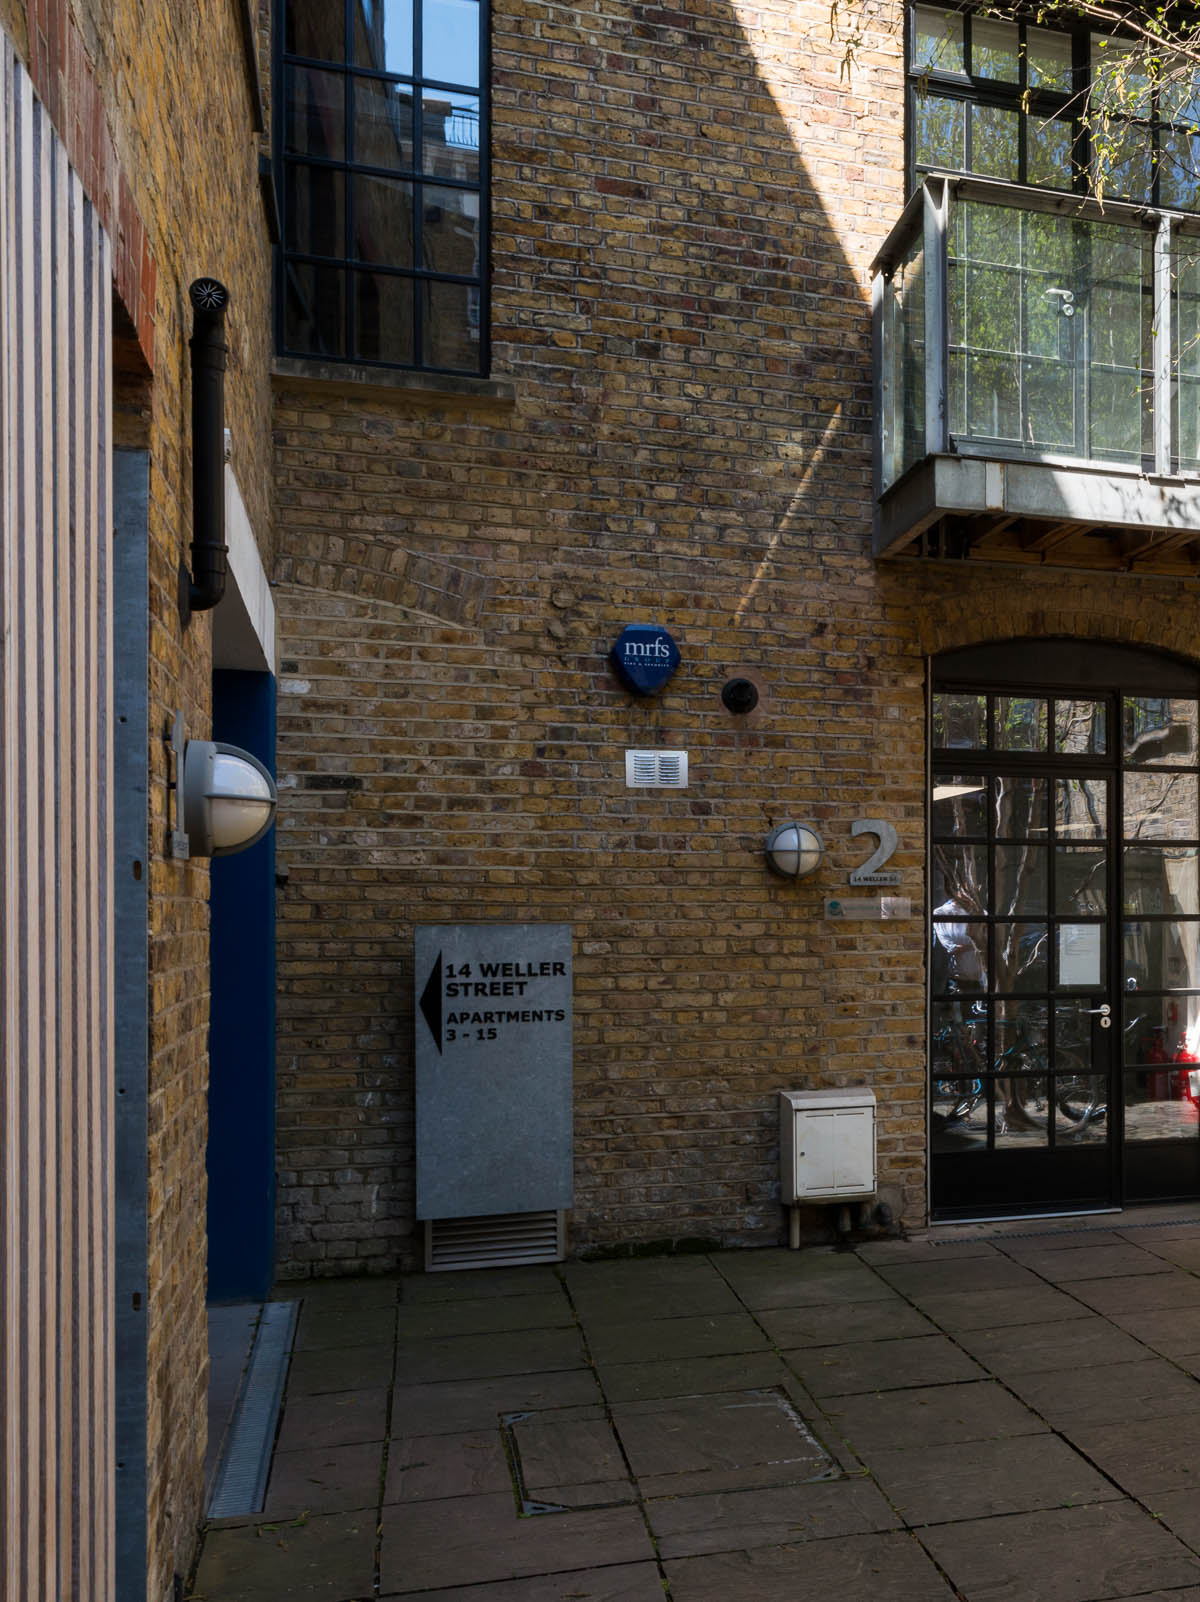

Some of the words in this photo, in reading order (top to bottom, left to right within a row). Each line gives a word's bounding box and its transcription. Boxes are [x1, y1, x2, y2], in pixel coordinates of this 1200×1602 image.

[624, 636, 670, 657] mrfs
[850, 819, 900, 886] 2
[445, 963, 472, 979] 14
[480, 962, 566, 978] WELLER
[445, 981, 528, 997] STREET
[446, 1009, 566, 1025] APARTMENTS
[446, 1028, 456, 1041] 3
[476, 1028, 497, 1040] 15
